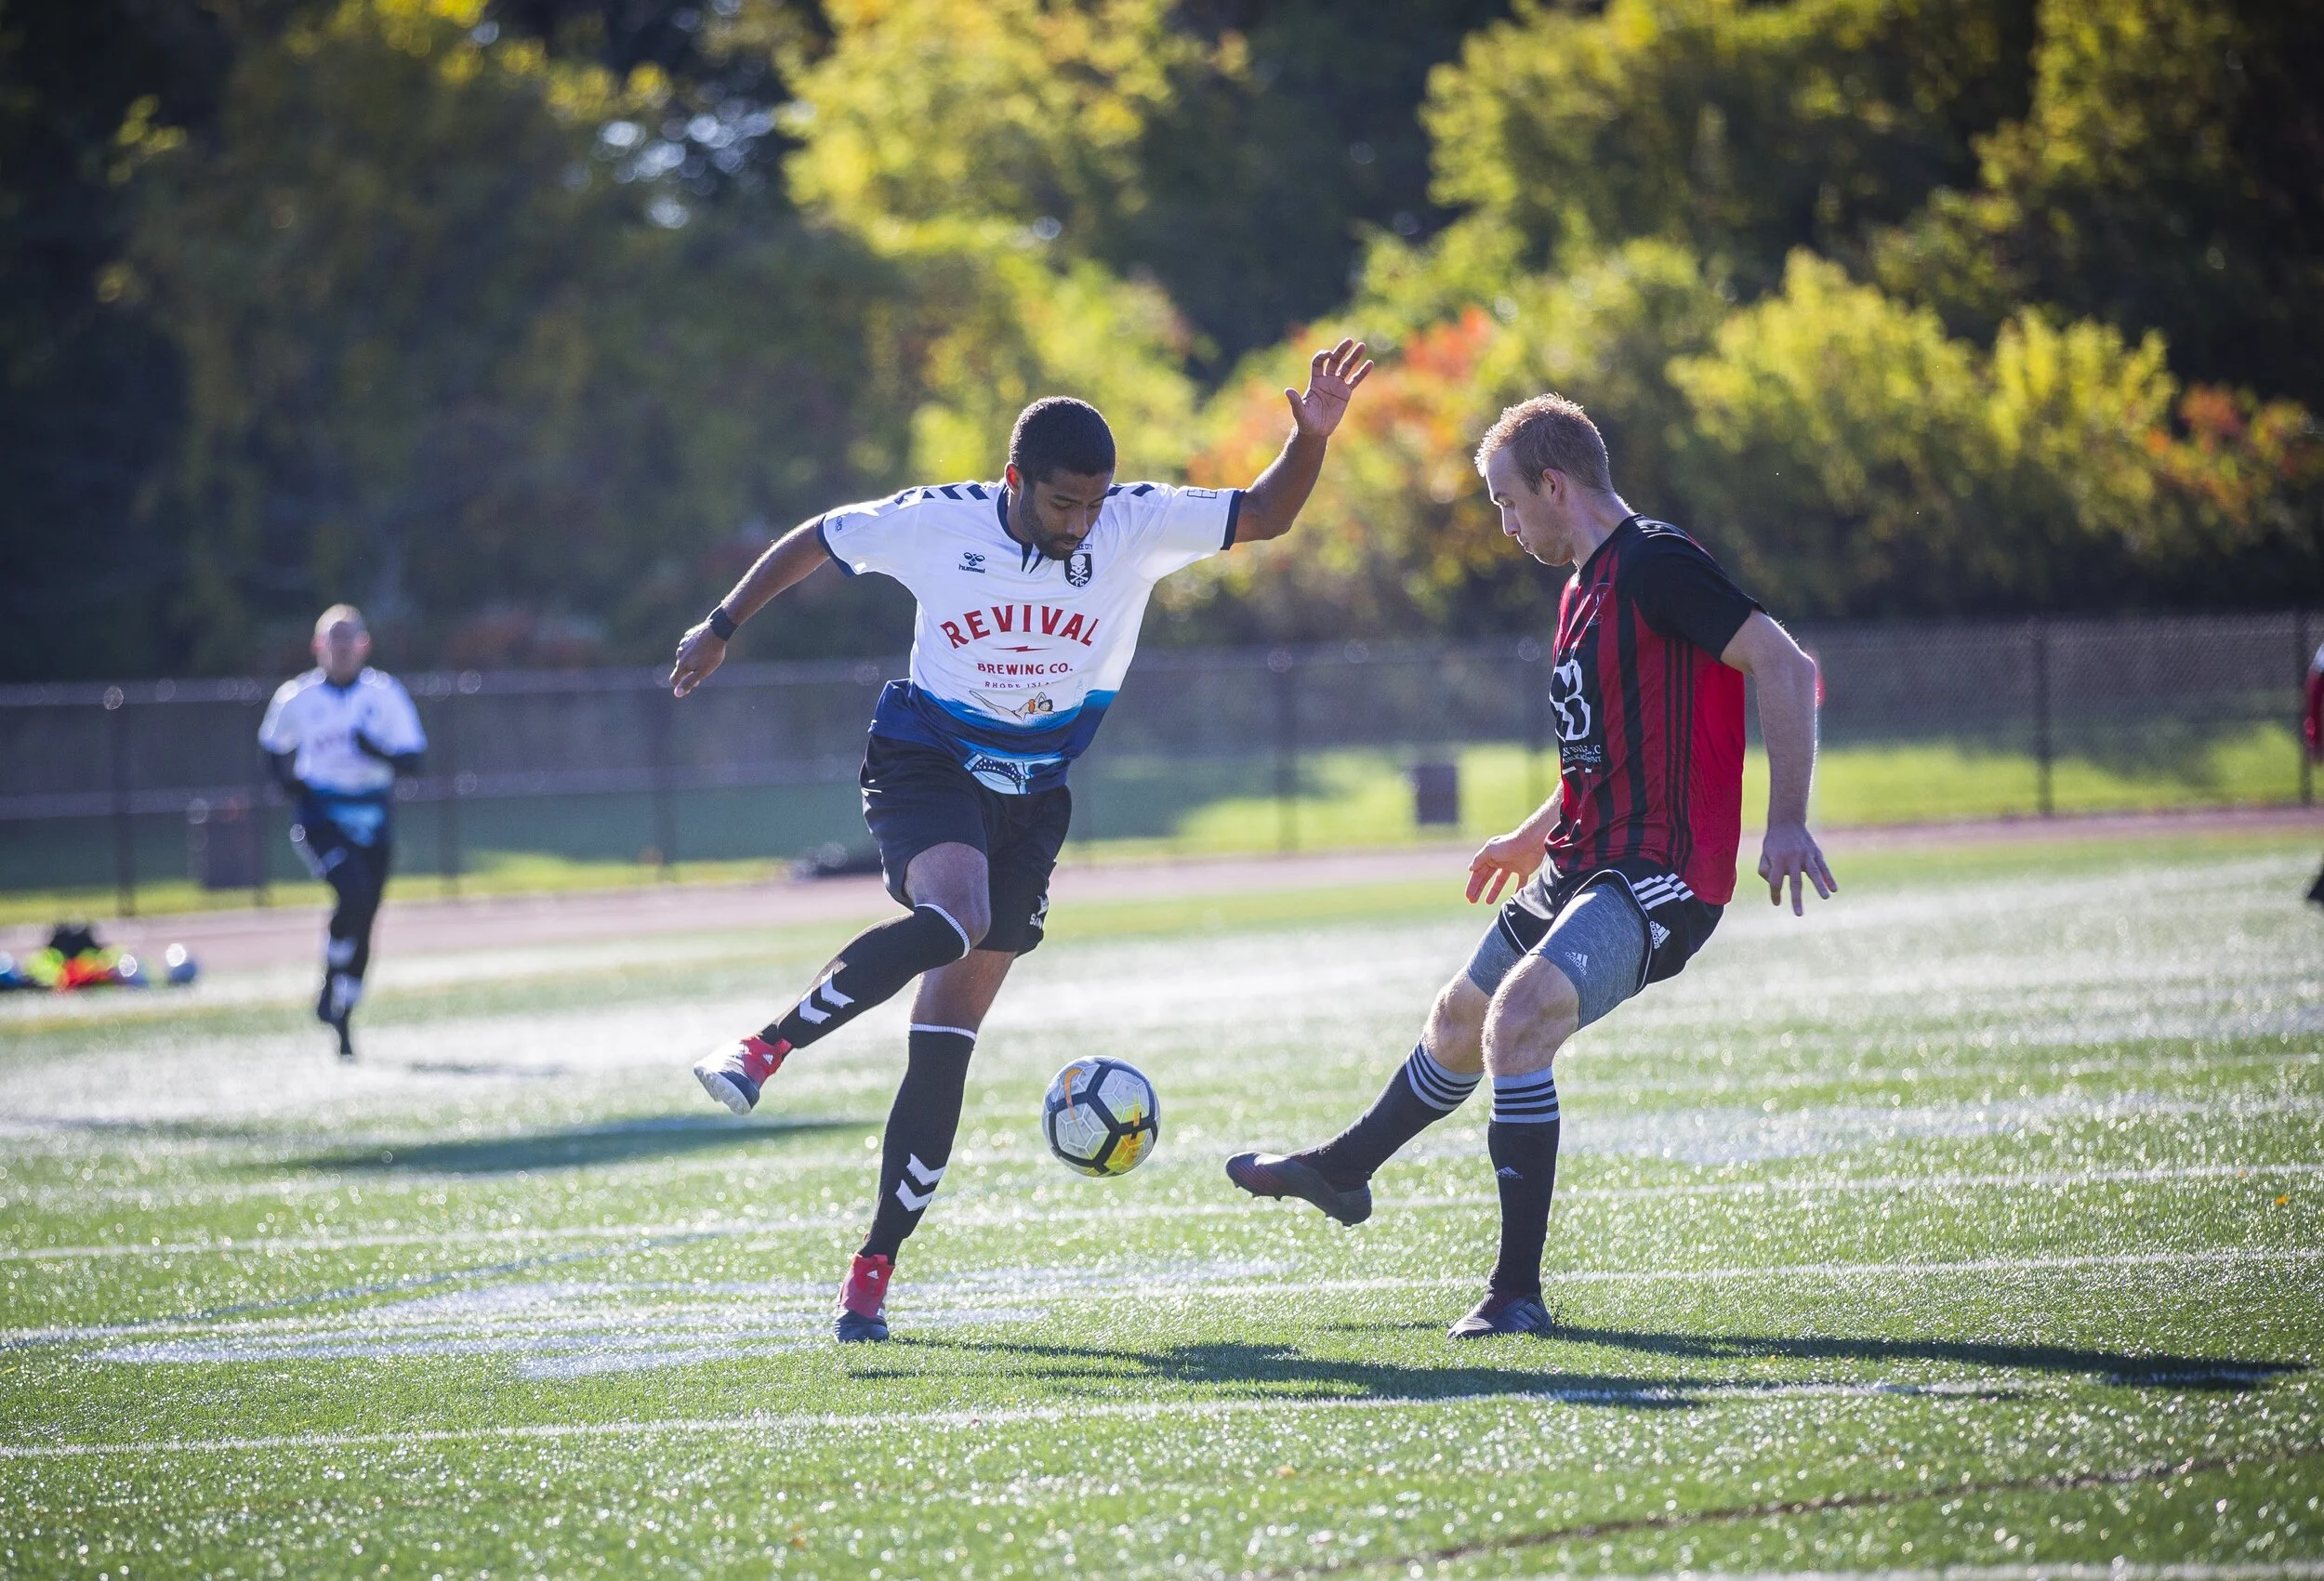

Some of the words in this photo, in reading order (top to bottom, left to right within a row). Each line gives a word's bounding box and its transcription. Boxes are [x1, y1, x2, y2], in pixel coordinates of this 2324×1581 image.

[958, 563, 985, 573] hummel
[940, 604, 1099, 649] REVIVAL
[977, 663, 1045, 675] BREWING
[1050, 663, 1073, 674] CO.
[1565, 951, 1588, 976] adidas
